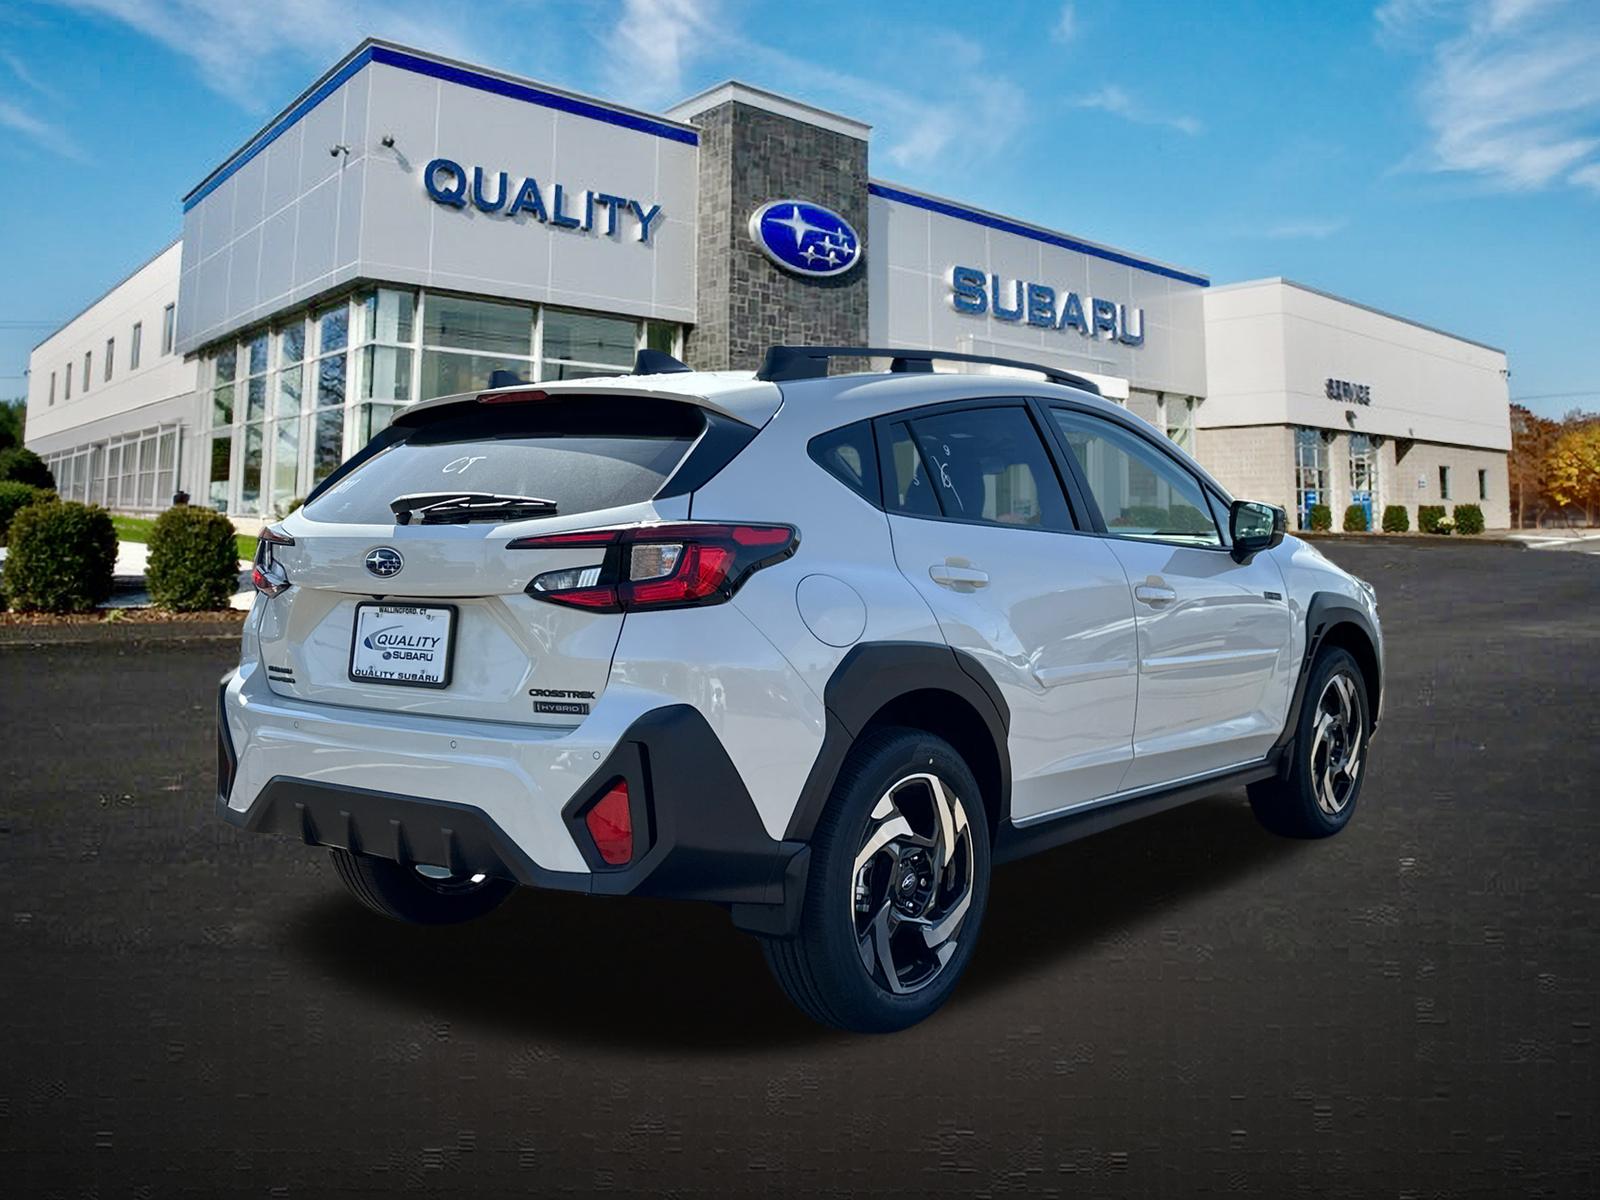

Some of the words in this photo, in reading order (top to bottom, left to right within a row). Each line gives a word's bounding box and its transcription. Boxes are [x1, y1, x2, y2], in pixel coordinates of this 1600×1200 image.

[424, 158, 661, 242] QUALITY
[951, 265, 1145, 346] SUBARU
[377, 634, 441, 648] QUALITY
[392, 651, 434, 661] SUBARU
[354, 669, 395, 679] QUALITY
[398, 673, 439, 682] SUBARU
[529, 688, 595, 699] CROSSTREK
[541, 704, 580, 712] HYBRID
